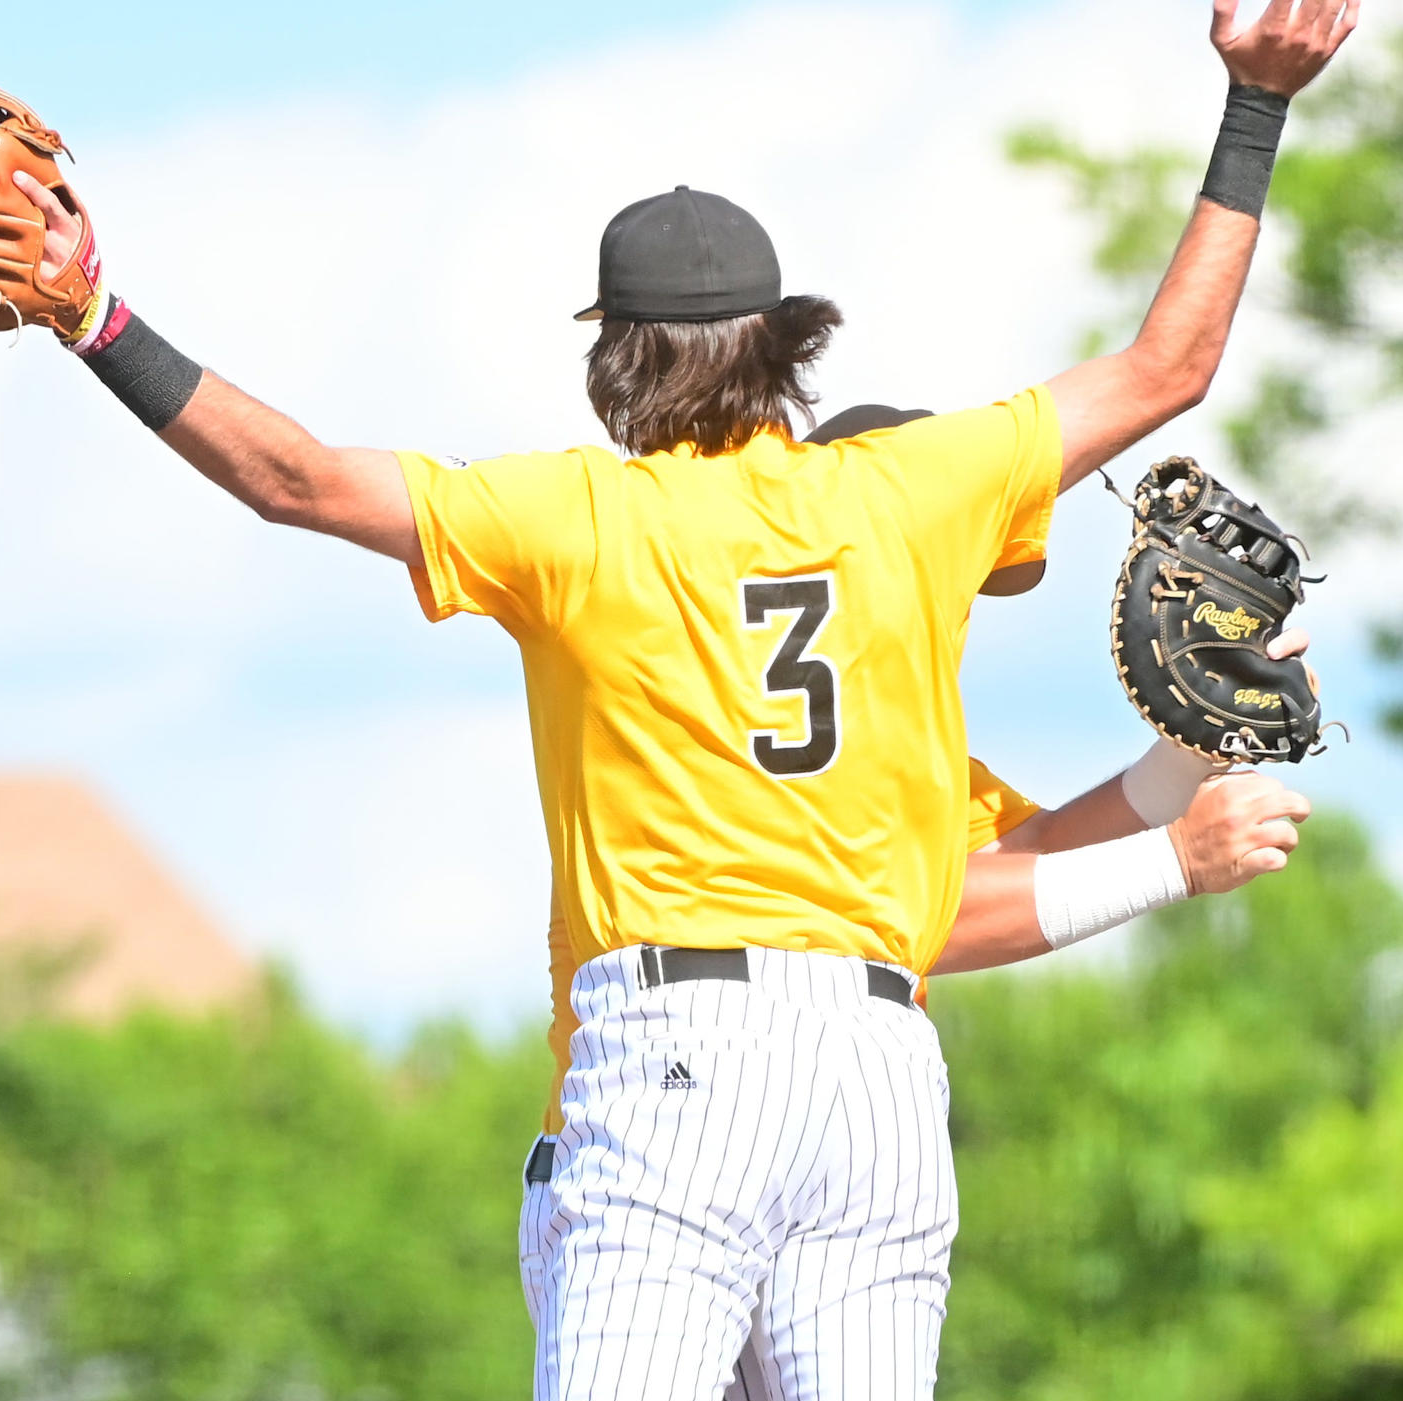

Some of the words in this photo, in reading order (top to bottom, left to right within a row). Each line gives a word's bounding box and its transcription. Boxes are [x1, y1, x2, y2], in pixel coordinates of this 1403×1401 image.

[1193, 601, 1261, 638] Rawlings
[738, 572, 842, 780] 3
[660, 1080, 697, 1090] adidas
